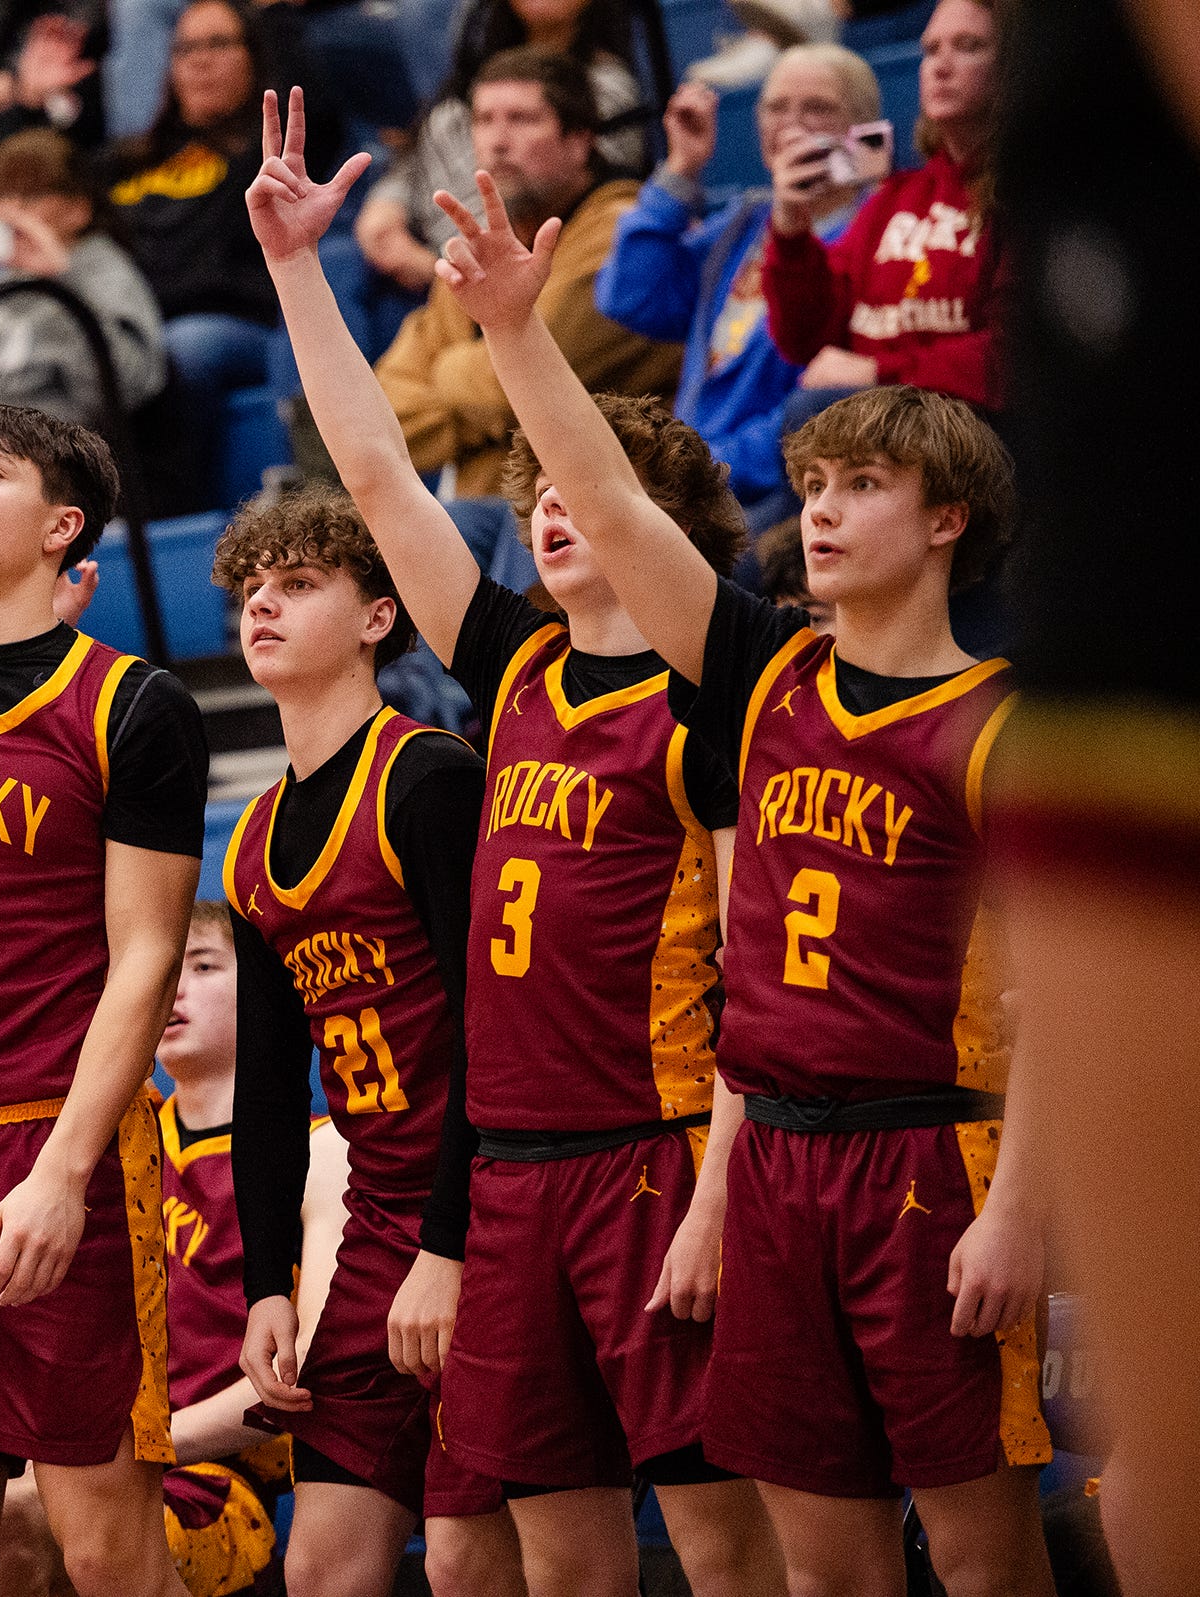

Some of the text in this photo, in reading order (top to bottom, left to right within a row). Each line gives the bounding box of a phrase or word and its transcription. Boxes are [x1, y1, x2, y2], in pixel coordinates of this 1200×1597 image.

[486, 760, 615, 852] ROCKY
[756, 766, 914, 867] ROCKY
[284, 931, 396, 1005] ROCKY
[490, 857, 542, 978] 3
[783, 867, 841, 991] 2
[323, 1006, 411, 1115] 21
